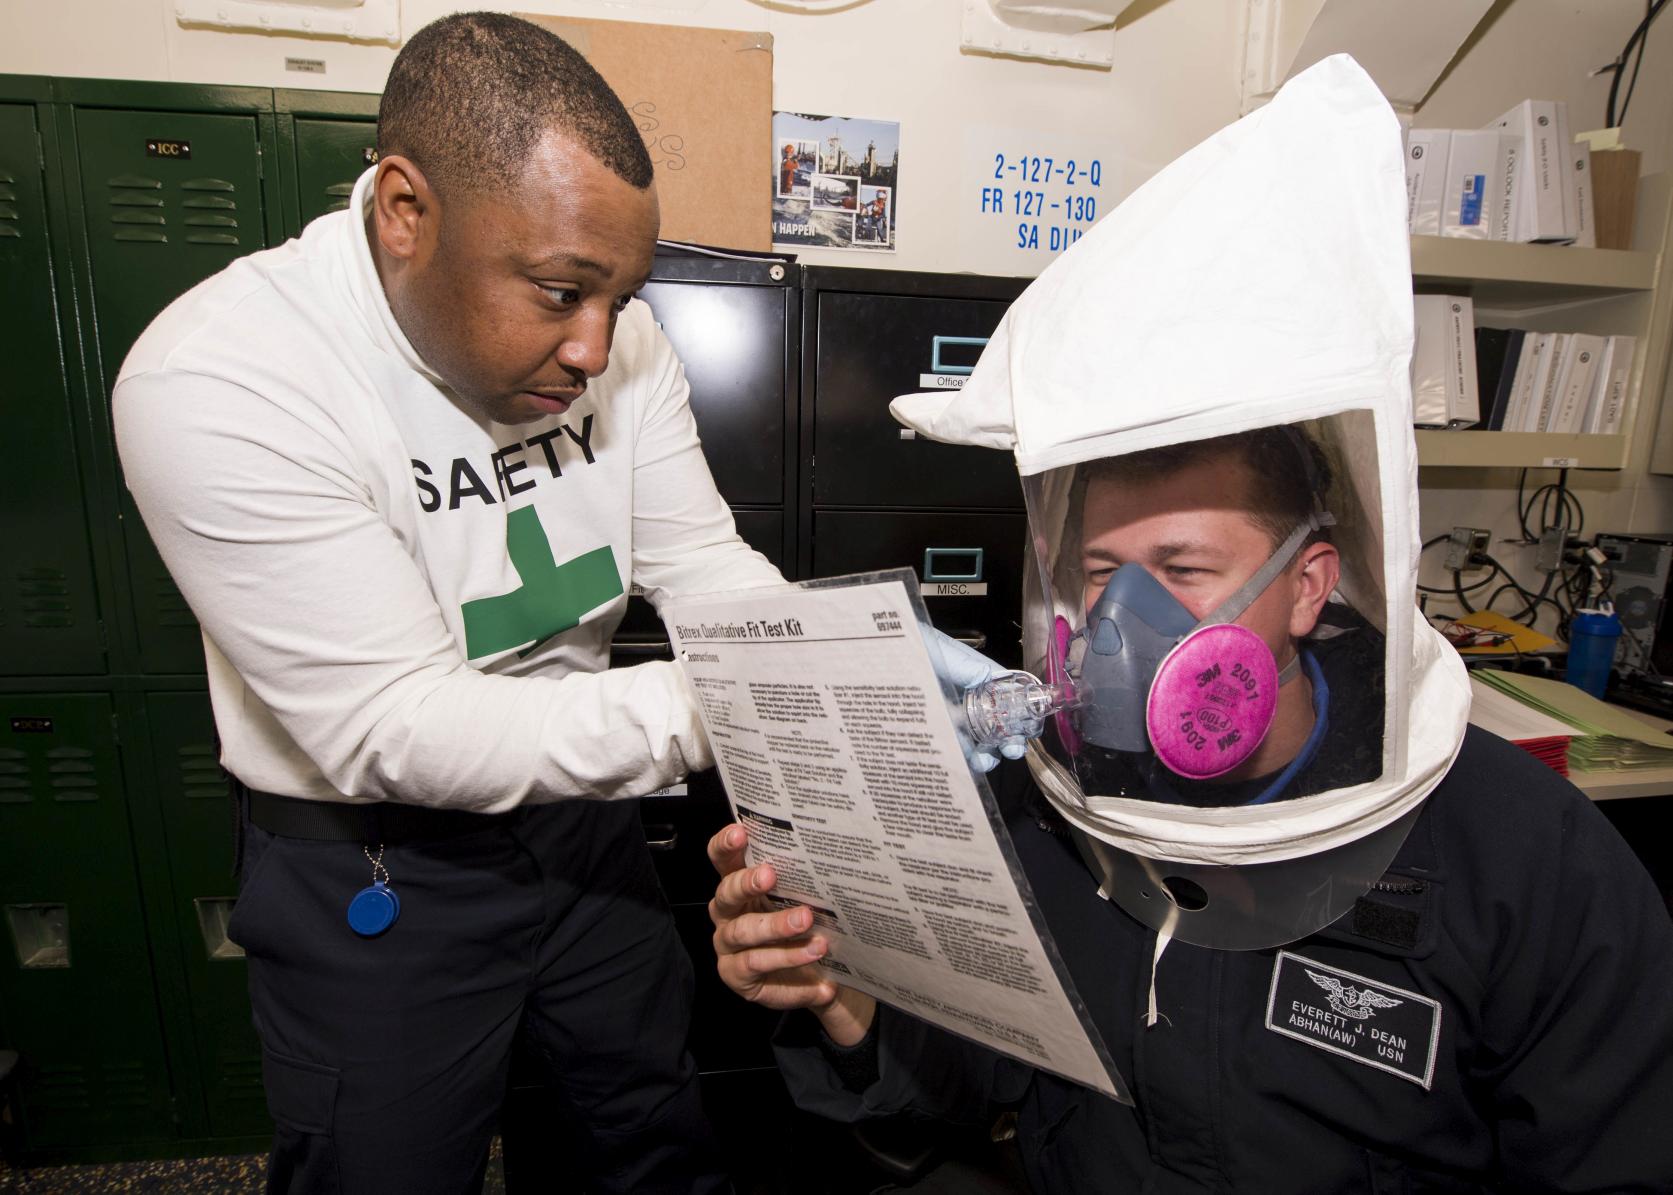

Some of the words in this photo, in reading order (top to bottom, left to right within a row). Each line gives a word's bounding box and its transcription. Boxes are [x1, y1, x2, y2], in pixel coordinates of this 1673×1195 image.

[157, 143, 180, 155] ICC
[994, 153, 1101, 187] 2-127-2-Q
[982, 187, 1003, 213] FR
[779, 222, 816, 237] HAPPEN
[1018, 223, 1038, 250] SA
[937, 376, 964, 387] Office
[937, 583, 970, 595] MISC.
[675, 625, 702, 640] Bitrex
[700, 622, 747, 639] Qualitative
[746, 621, 762, 638] Fit
[760, 620, 786, 638] Test
[784, 618, 804, 637] Kit
[1230, 663, 1259, 701] 2091
[1292, 1000, 1348, 1028] EVERETT
[1354, 1023, 1365, 1036] J.
[1371, 1027, 1407, 1050] DEAN
[1289, 1013, 1356, 1048] ABHAN(AW)
[1377, 1044, 1404, 1064] USN
